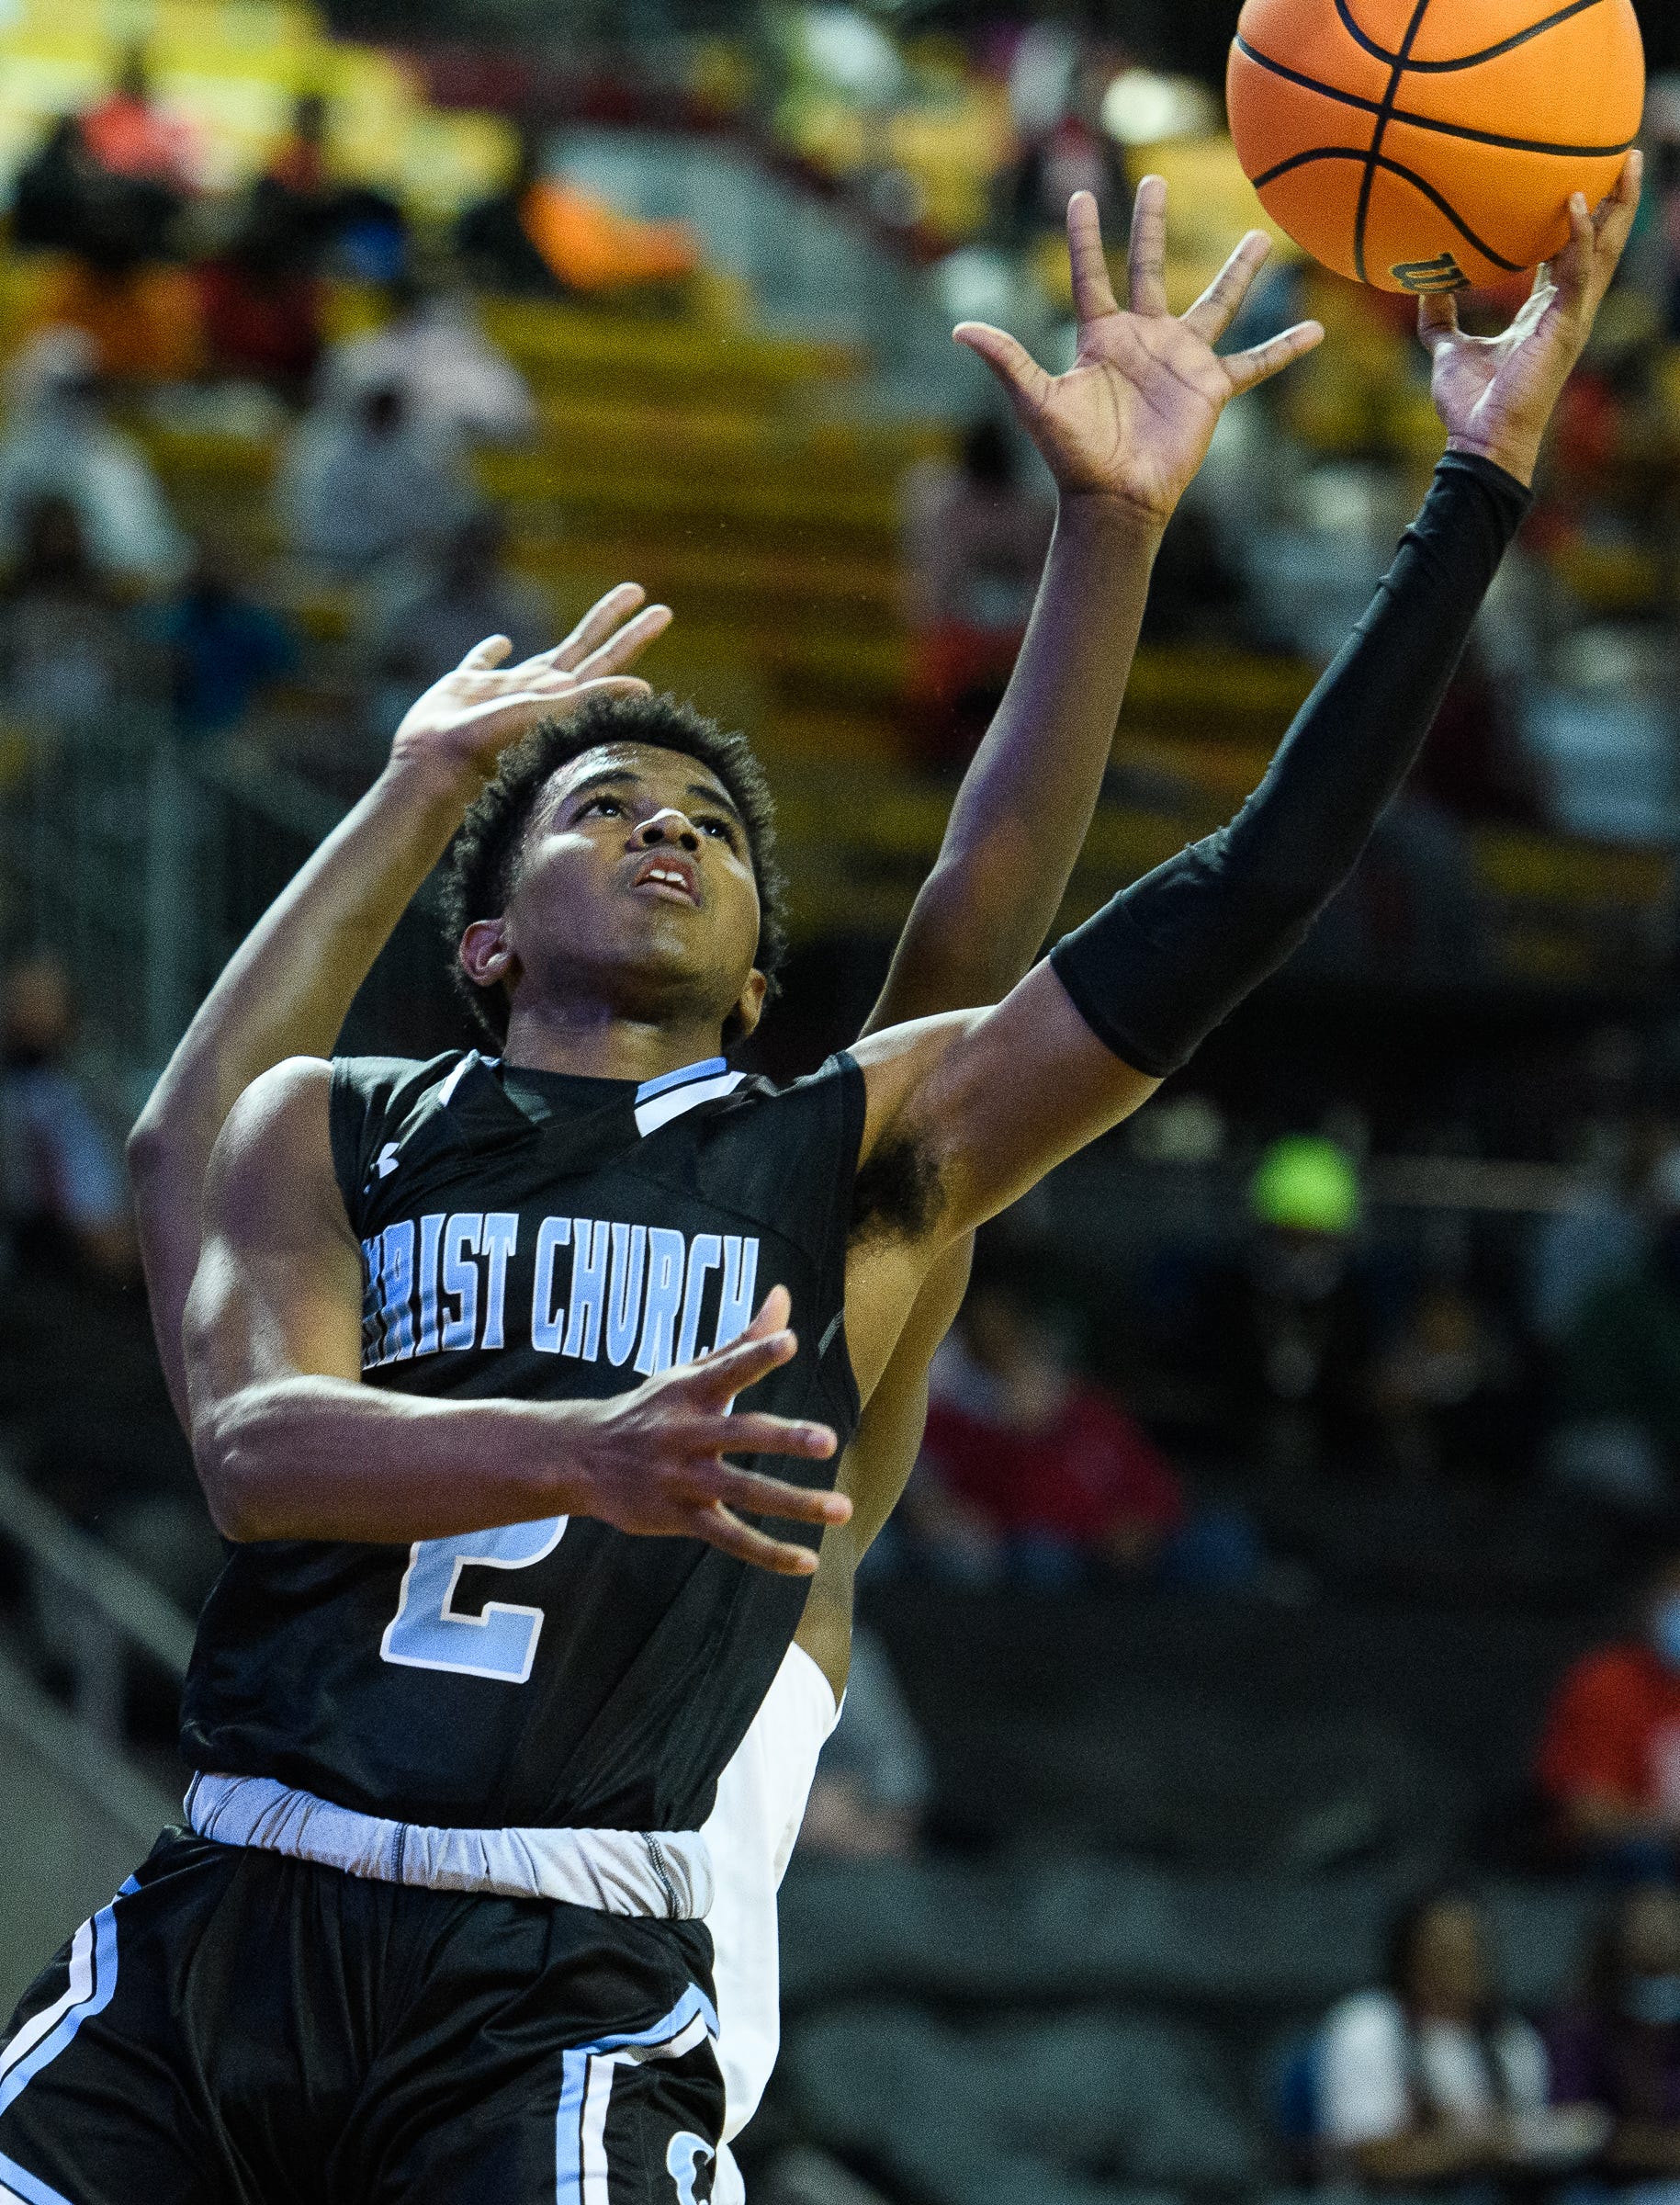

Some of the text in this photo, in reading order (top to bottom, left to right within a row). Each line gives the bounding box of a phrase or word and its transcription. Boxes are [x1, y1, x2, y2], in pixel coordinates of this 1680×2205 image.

[362, 1213, 760, 1416] HRIST CHURCH
[379, 1514, 569, 1684] 2
